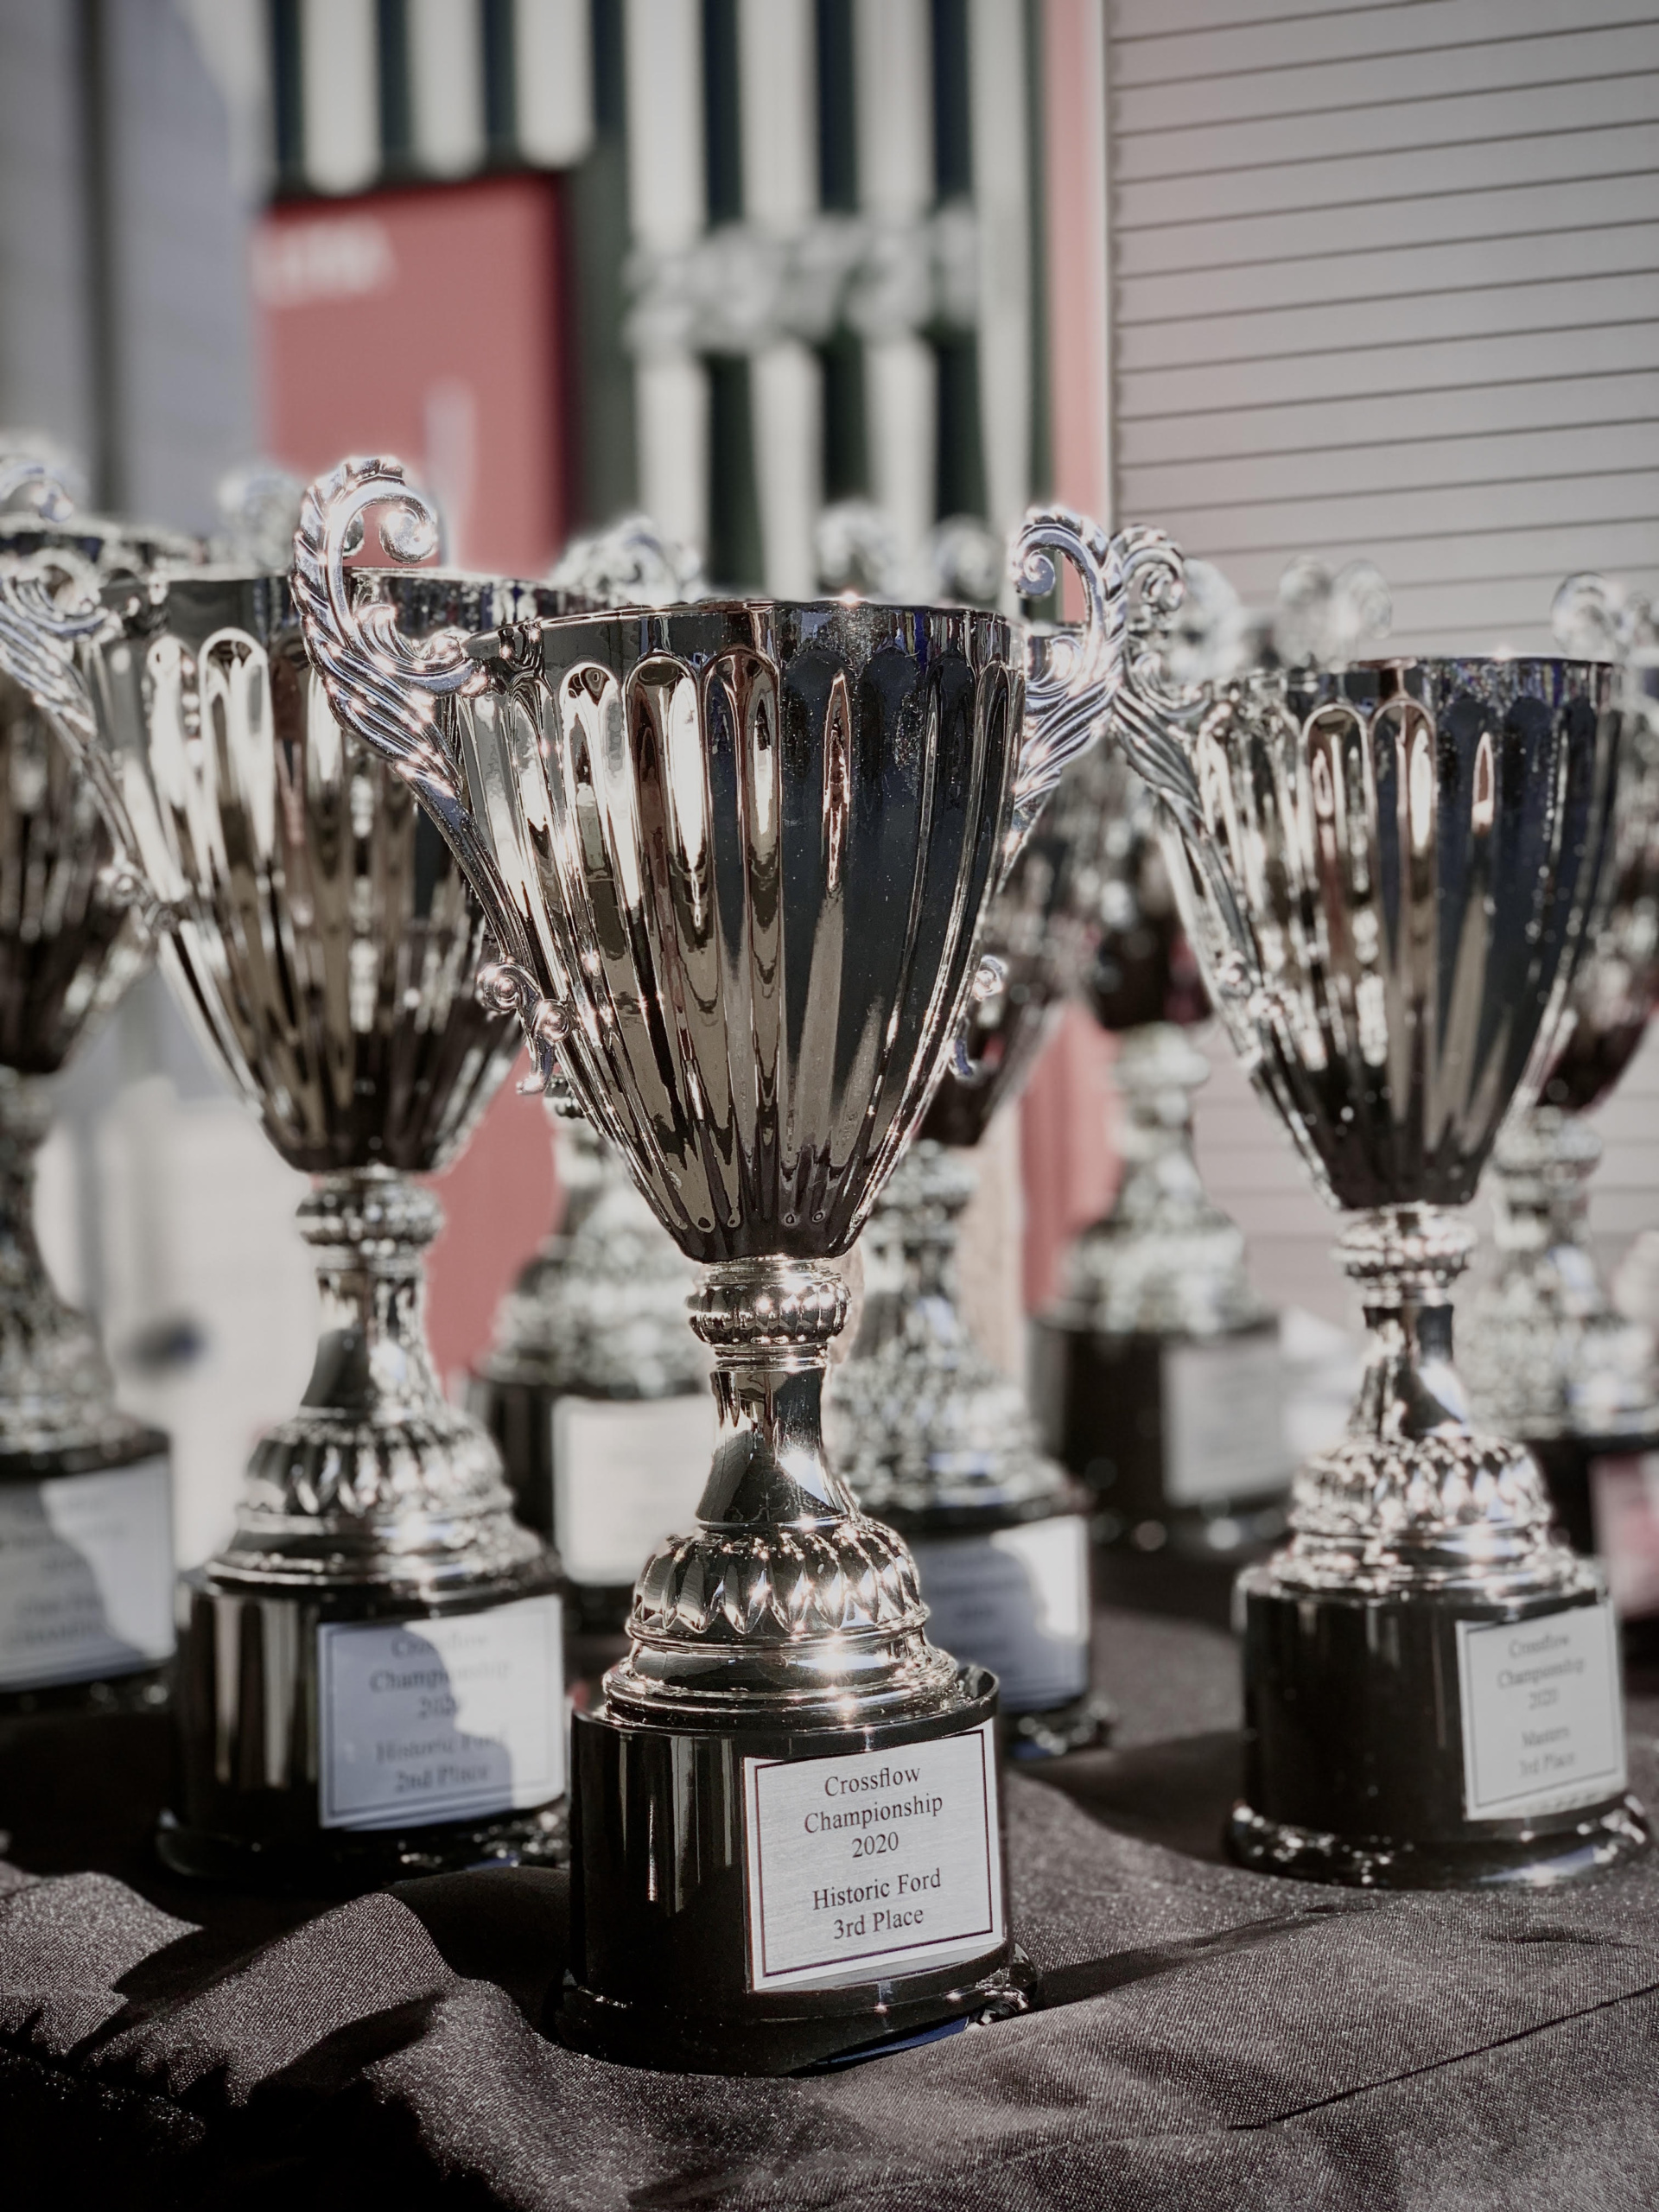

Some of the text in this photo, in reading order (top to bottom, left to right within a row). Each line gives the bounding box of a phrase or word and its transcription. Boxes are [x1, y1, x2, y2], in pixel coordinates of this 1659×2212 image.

[823, 1767, 921, 1796] Crossflow
[804, 1793, 943, 1834] Championship
[851, 1831, 899, 1859] 2020
[812, 1867, 942, 1911] Historic Ford
[833, 1909, 925, 1940] 3rd Place
